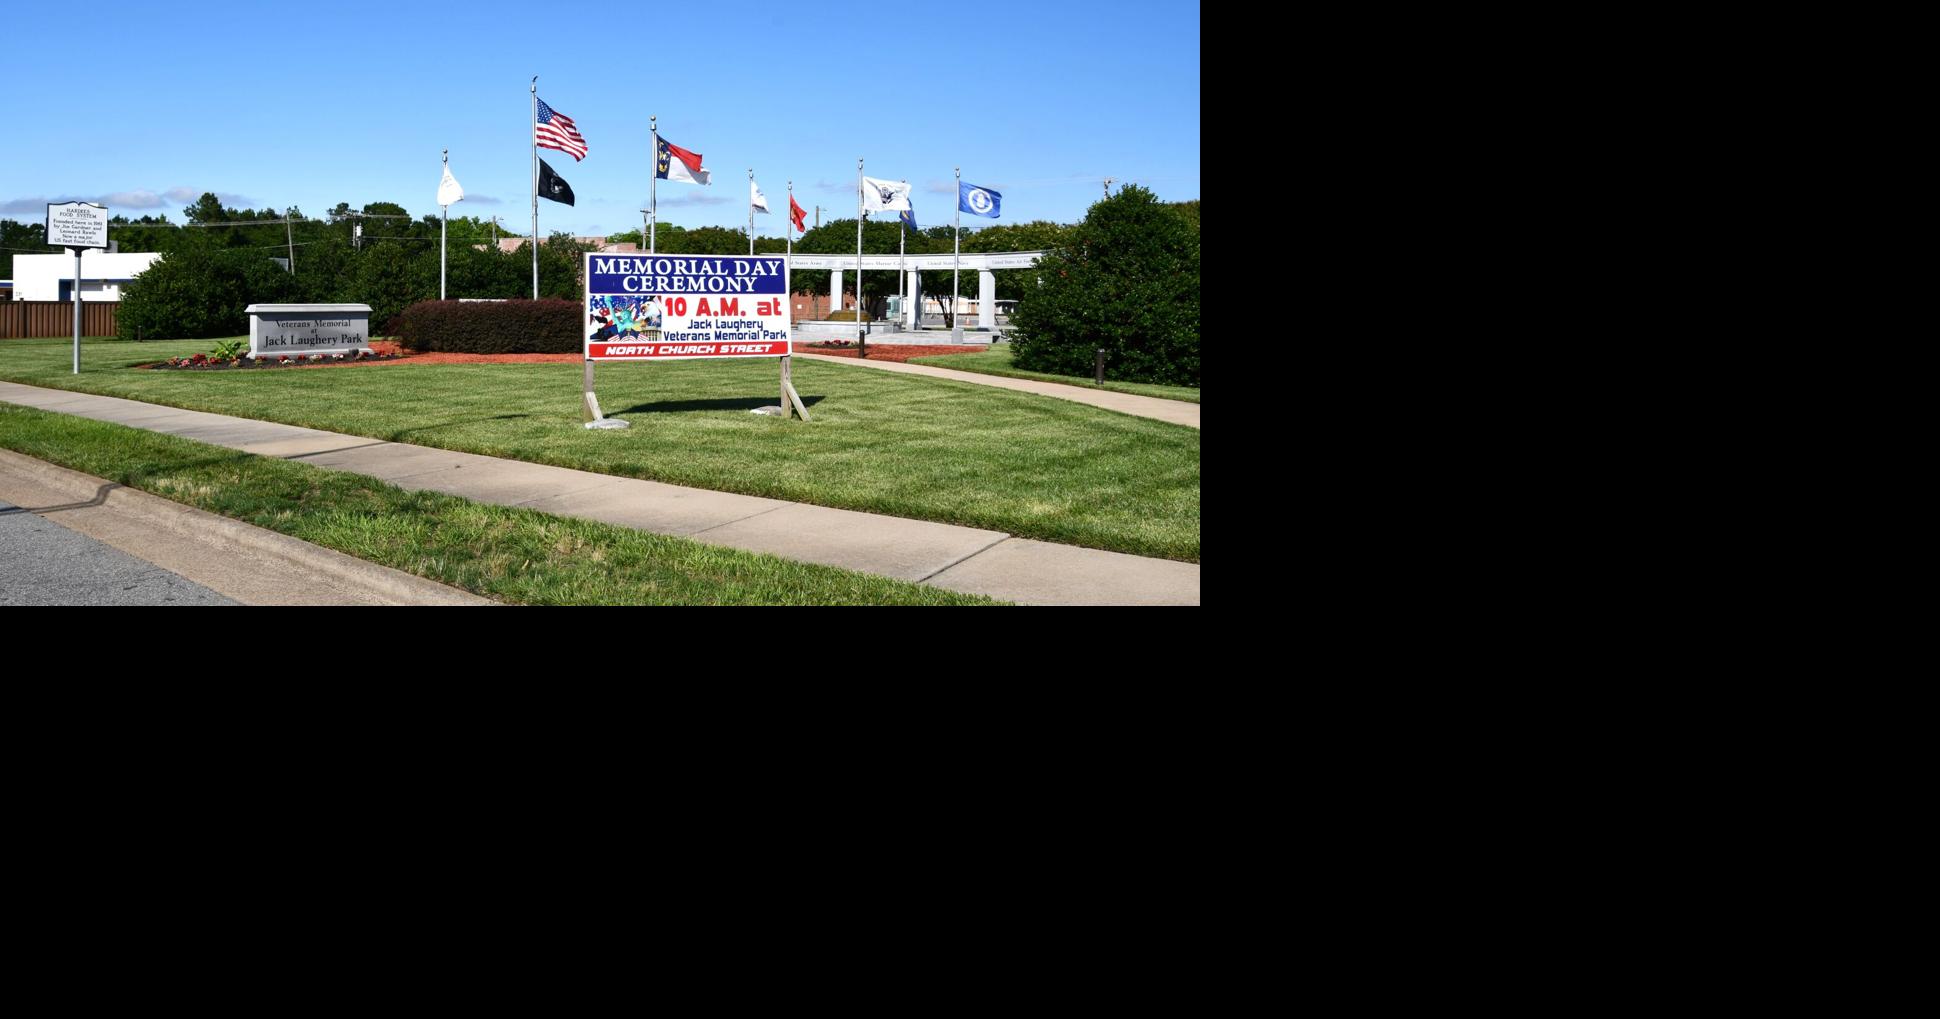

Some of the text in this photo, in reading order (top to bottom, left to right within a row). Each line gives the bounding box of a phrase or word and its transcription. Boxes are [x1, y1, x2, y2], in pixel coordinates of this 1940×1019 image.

[594, 258, 781, 276] MEMORIAL DAY
[622, 275, 758, 292] CEREMONY
[665, 296, 782, 317] 10 A.M. at
[275, 319, 351, 328] Veterans Memorial
[687, 319, 764, 332] Jack Laughery
[264, 333, 362, 348] Jack Laughery Park
[663, 329, 787, 341] Veterans Memorial Park
[605, 344, 773, 355] NORTH CHURCH STREET
